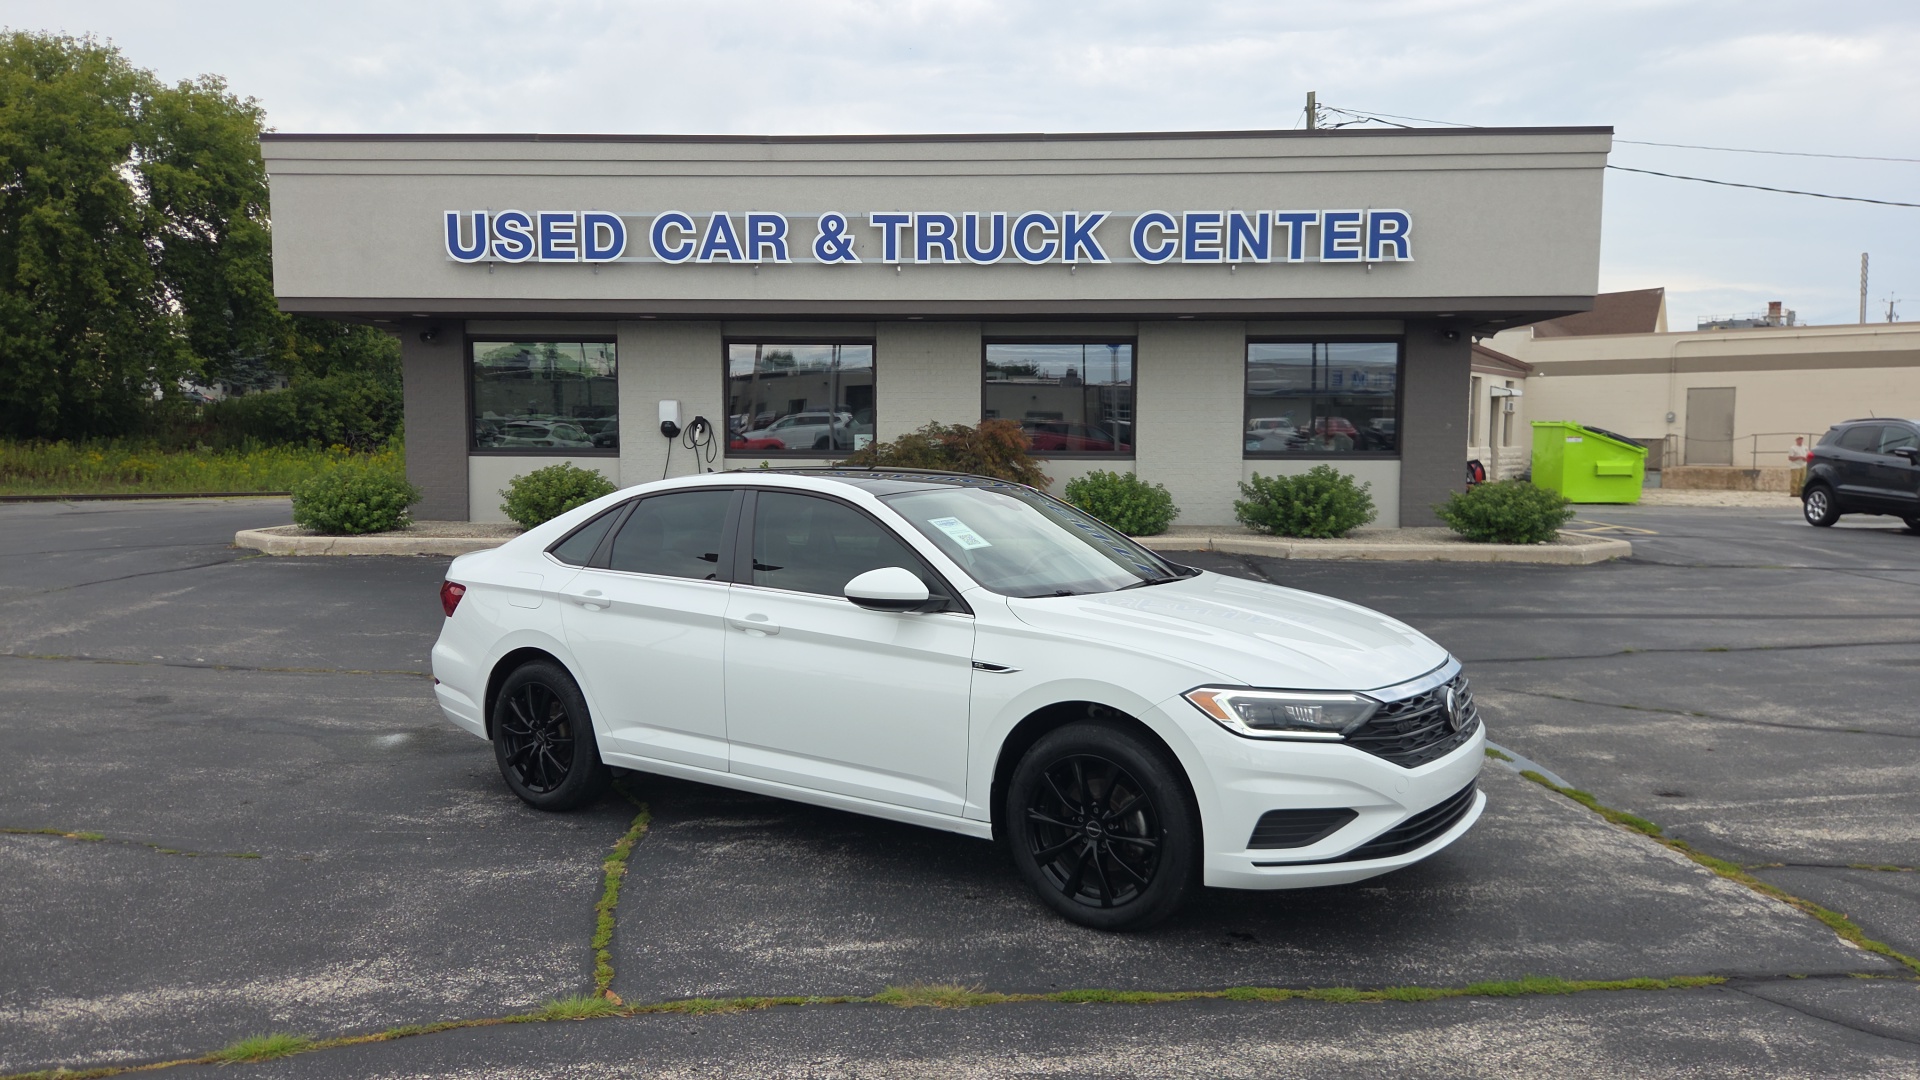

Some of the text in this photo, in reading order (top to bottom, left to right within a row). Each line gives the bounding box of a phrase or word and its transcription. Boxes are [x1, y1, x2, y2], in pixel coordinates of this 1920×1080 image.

[444, 208, 1414, 265] USED CAR & TRUCK CENTER
